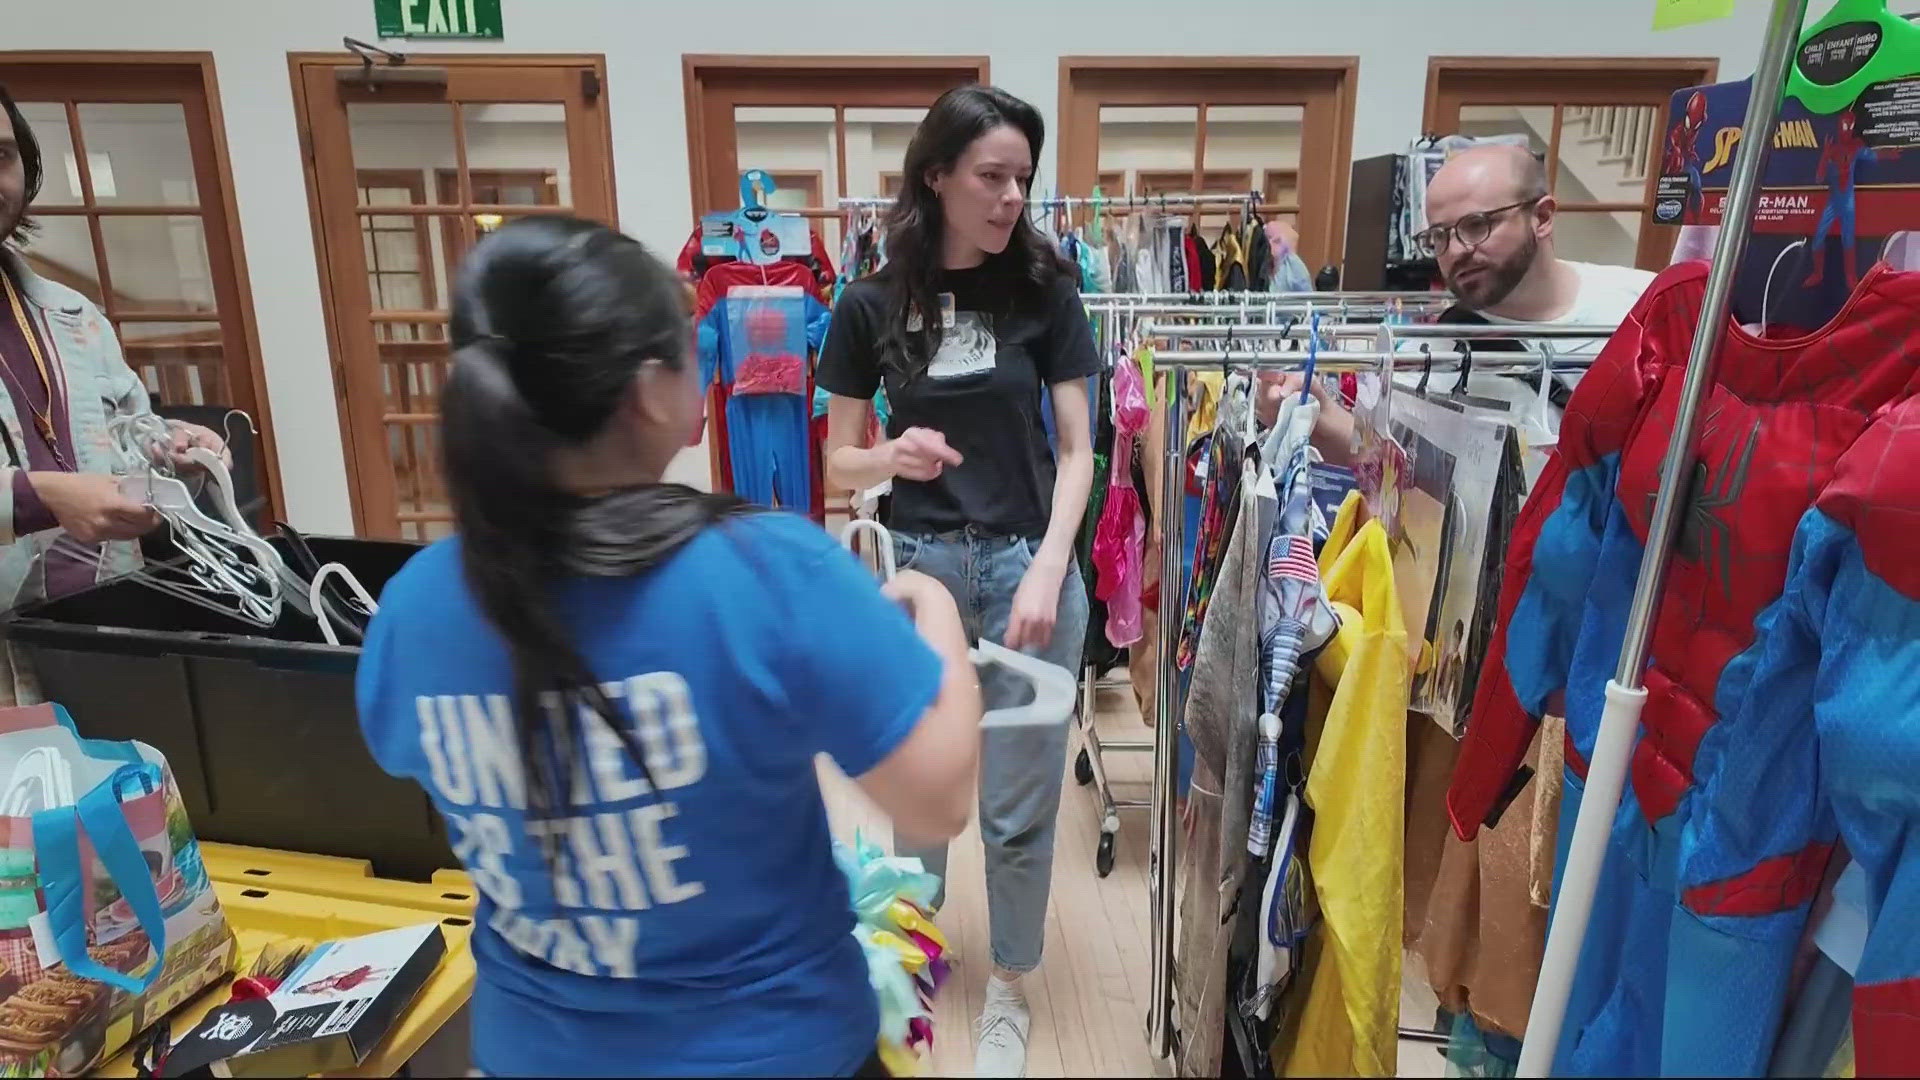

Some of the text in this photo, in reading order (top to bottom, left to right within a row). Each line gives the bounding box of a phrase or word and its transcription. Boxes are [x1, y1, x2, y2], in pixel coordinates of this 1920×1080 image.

[1804, 42, 1824, 54] CHILD
[1826, 37, 1855, 50] ENFANT
[1718, 195, 1808, 209] SR-MAN
[415, 671, 707, 809] UNTED
[525, 802, 706, 911] THE
